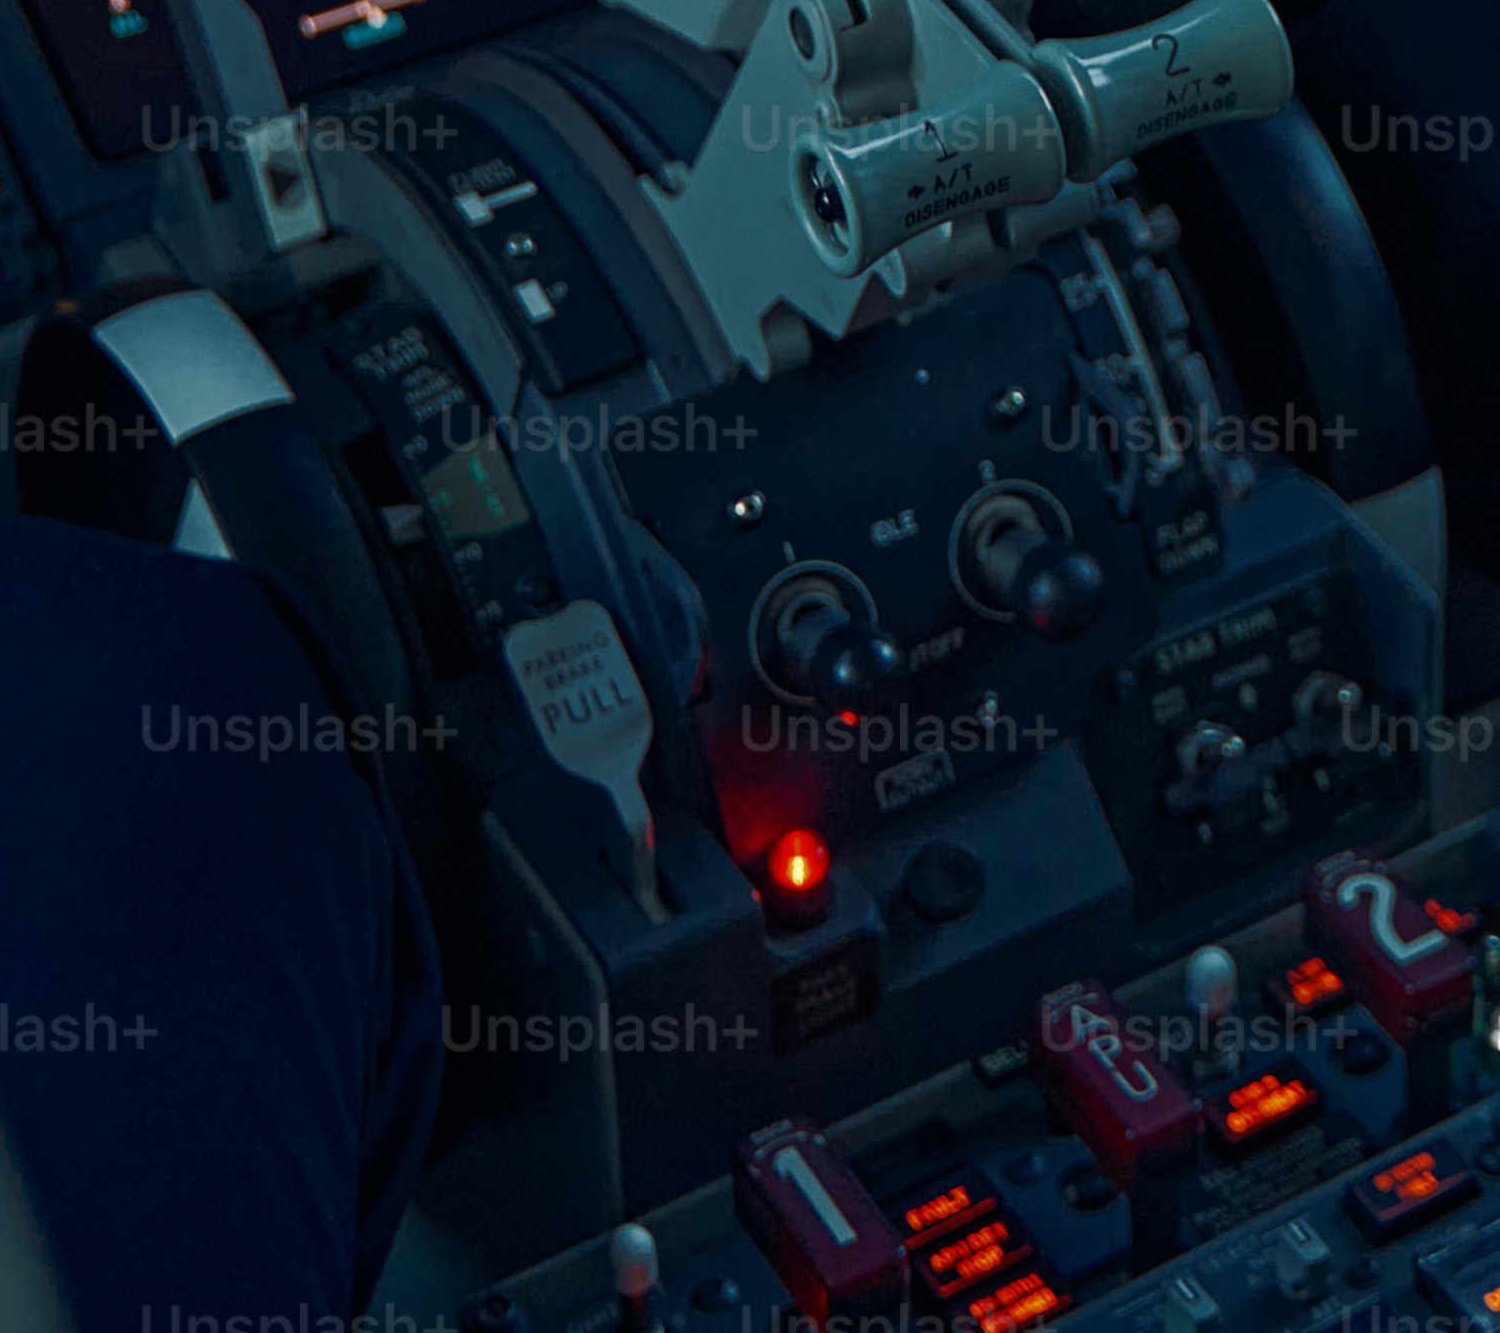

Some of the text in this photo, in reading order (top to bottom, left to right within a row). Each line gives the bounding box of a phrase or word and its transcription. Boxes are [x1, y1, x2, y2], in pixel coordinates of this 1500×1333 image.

[1151, 33, 1191, 78] 2
[1136, 91, 1238, 140] DISENGAGE
[1165, 80, 1203, 108] A/T
[923, 118, 958, 164] 1
[904, 175, 1011, 228] DISENGAGE
[933, 162, 975, 195] A/T
[523, 633, 611, 679] PARKING
[543, 657, 606, 693] BRAKE
[538, 677, 633, 735] PULL
[1336, 872, 1451, 968] 2
[1069, 1003, 1160, 1102] APU
[771, 1144, 858, 1248] 1
